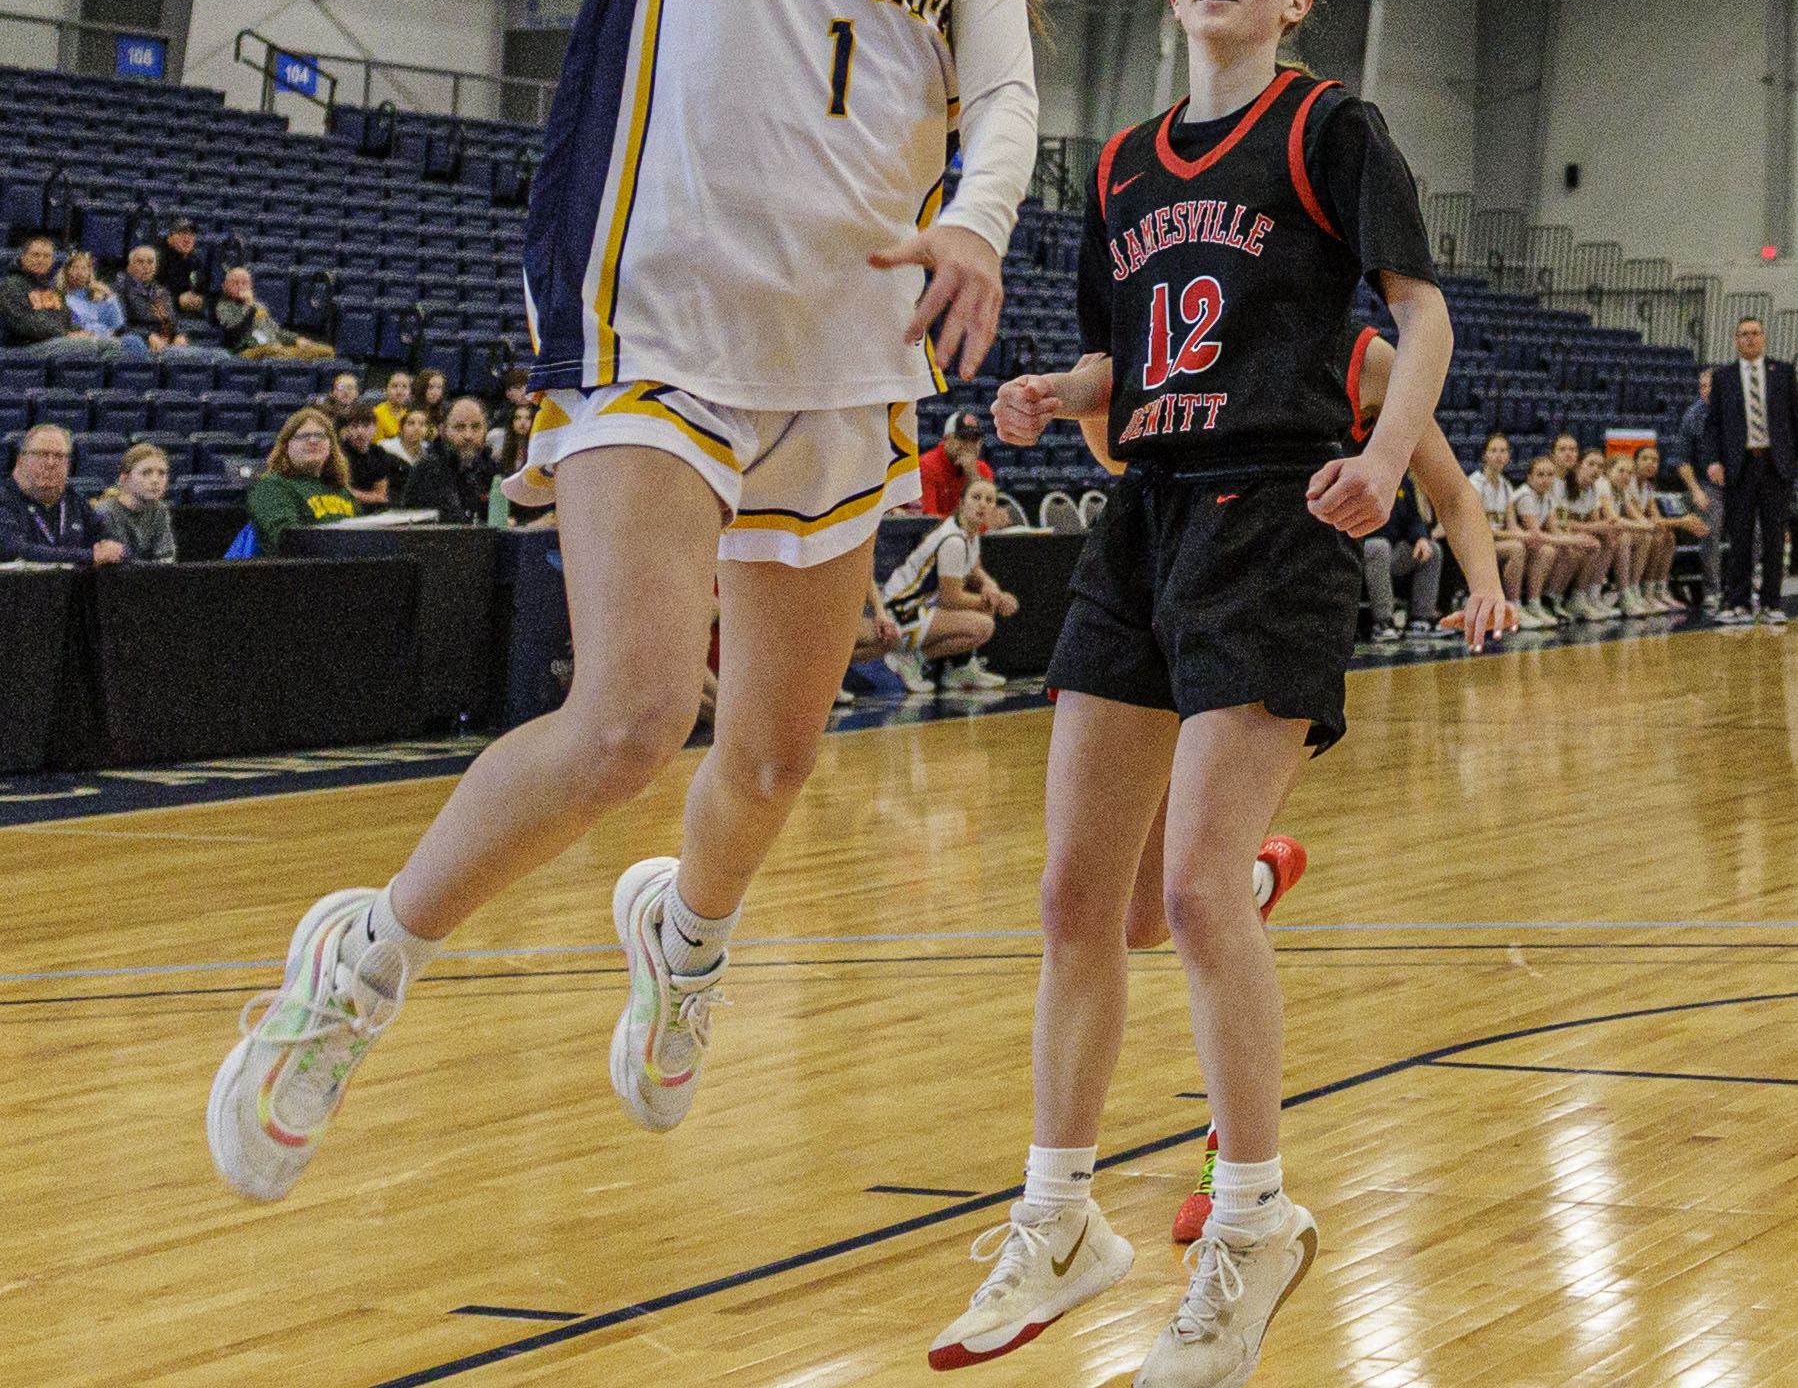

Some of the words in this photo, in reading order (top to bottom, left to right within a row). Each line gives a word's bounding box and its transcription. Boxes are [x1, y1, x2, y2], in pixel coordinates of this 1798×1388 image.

[284, 63, 310, 85] 104
[827, 17, 857, 118] 1
[1108, 200, 1275, 281] JAMESVILLE
[1143, 275, 1225, 391] 12
